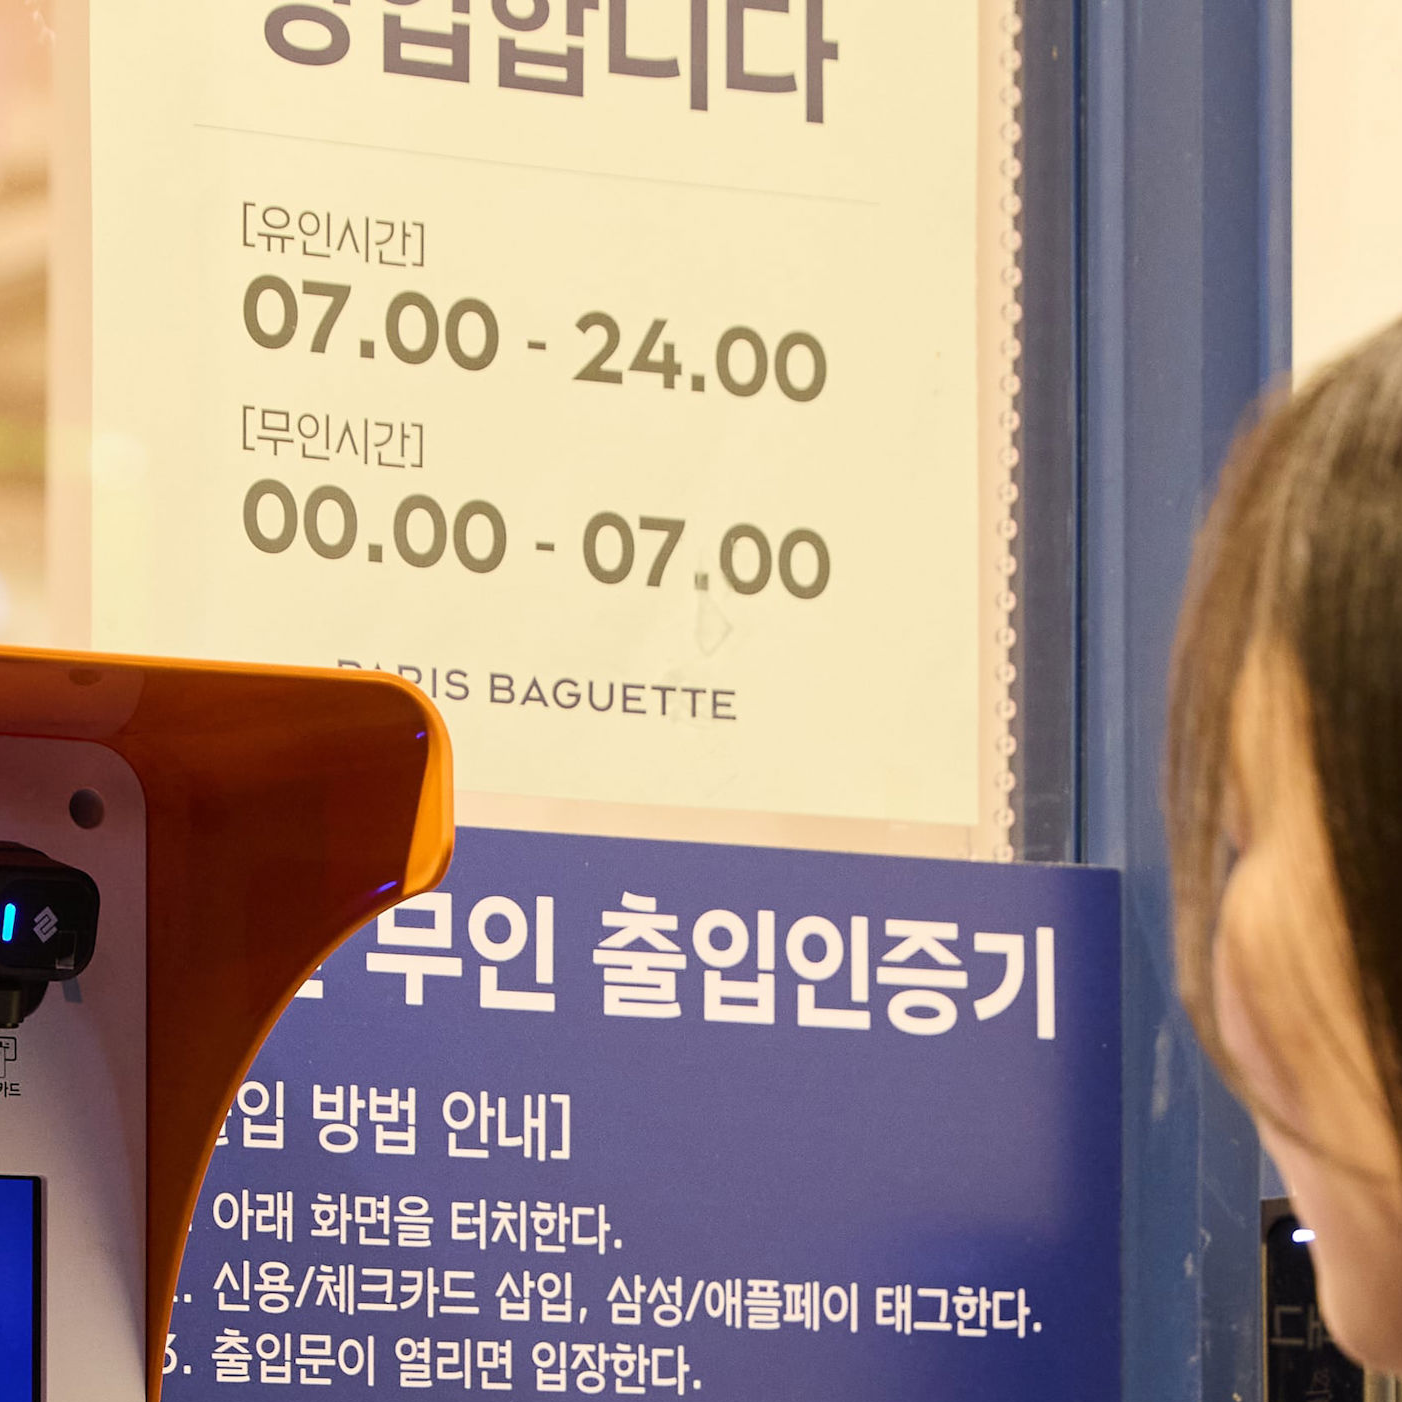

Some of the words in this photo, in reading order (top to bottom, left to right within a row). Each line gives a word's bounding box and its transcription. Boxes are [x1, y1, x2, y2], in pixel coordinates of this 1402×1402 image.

[242, 201, 425, 268] [유인시간]
[243, 274, 500, 372] 07.00
[572, 311, 827, 403] 24.00
[242, 404, 424, 469] [무인시간]
[242, 478, 507, 574] 00.00
[582, 511, 831, 600] 07.00
[489, 672, 737, 721] BAGUETTE
[366, 891, 556, 1013] 무인
[592, 891, 1055, 1040] 출입인증기
[312, 1084, 416, 1156] 방법
[442, 1090, 571, 1162] 안내]
[212, 1189, 293, 1243] 아래
[310, 1192, 434, 1248] 화면을
[451, 1198, 623, 1255] 터치한다.
[212, 1260, 480, 1319] 신용/체크카드
[495, 1270, 588, 1324] 삽입,
[606, 1274, 858, 1333] 삼성/애플페이
[875, 1283, 1042, 1339] 태그한다.
[211, 1327, 375, 1387] 출입문이
[395, 1337, 513, 1391] 열리면
[531, 1341, 702, 1396] 입장한다.
